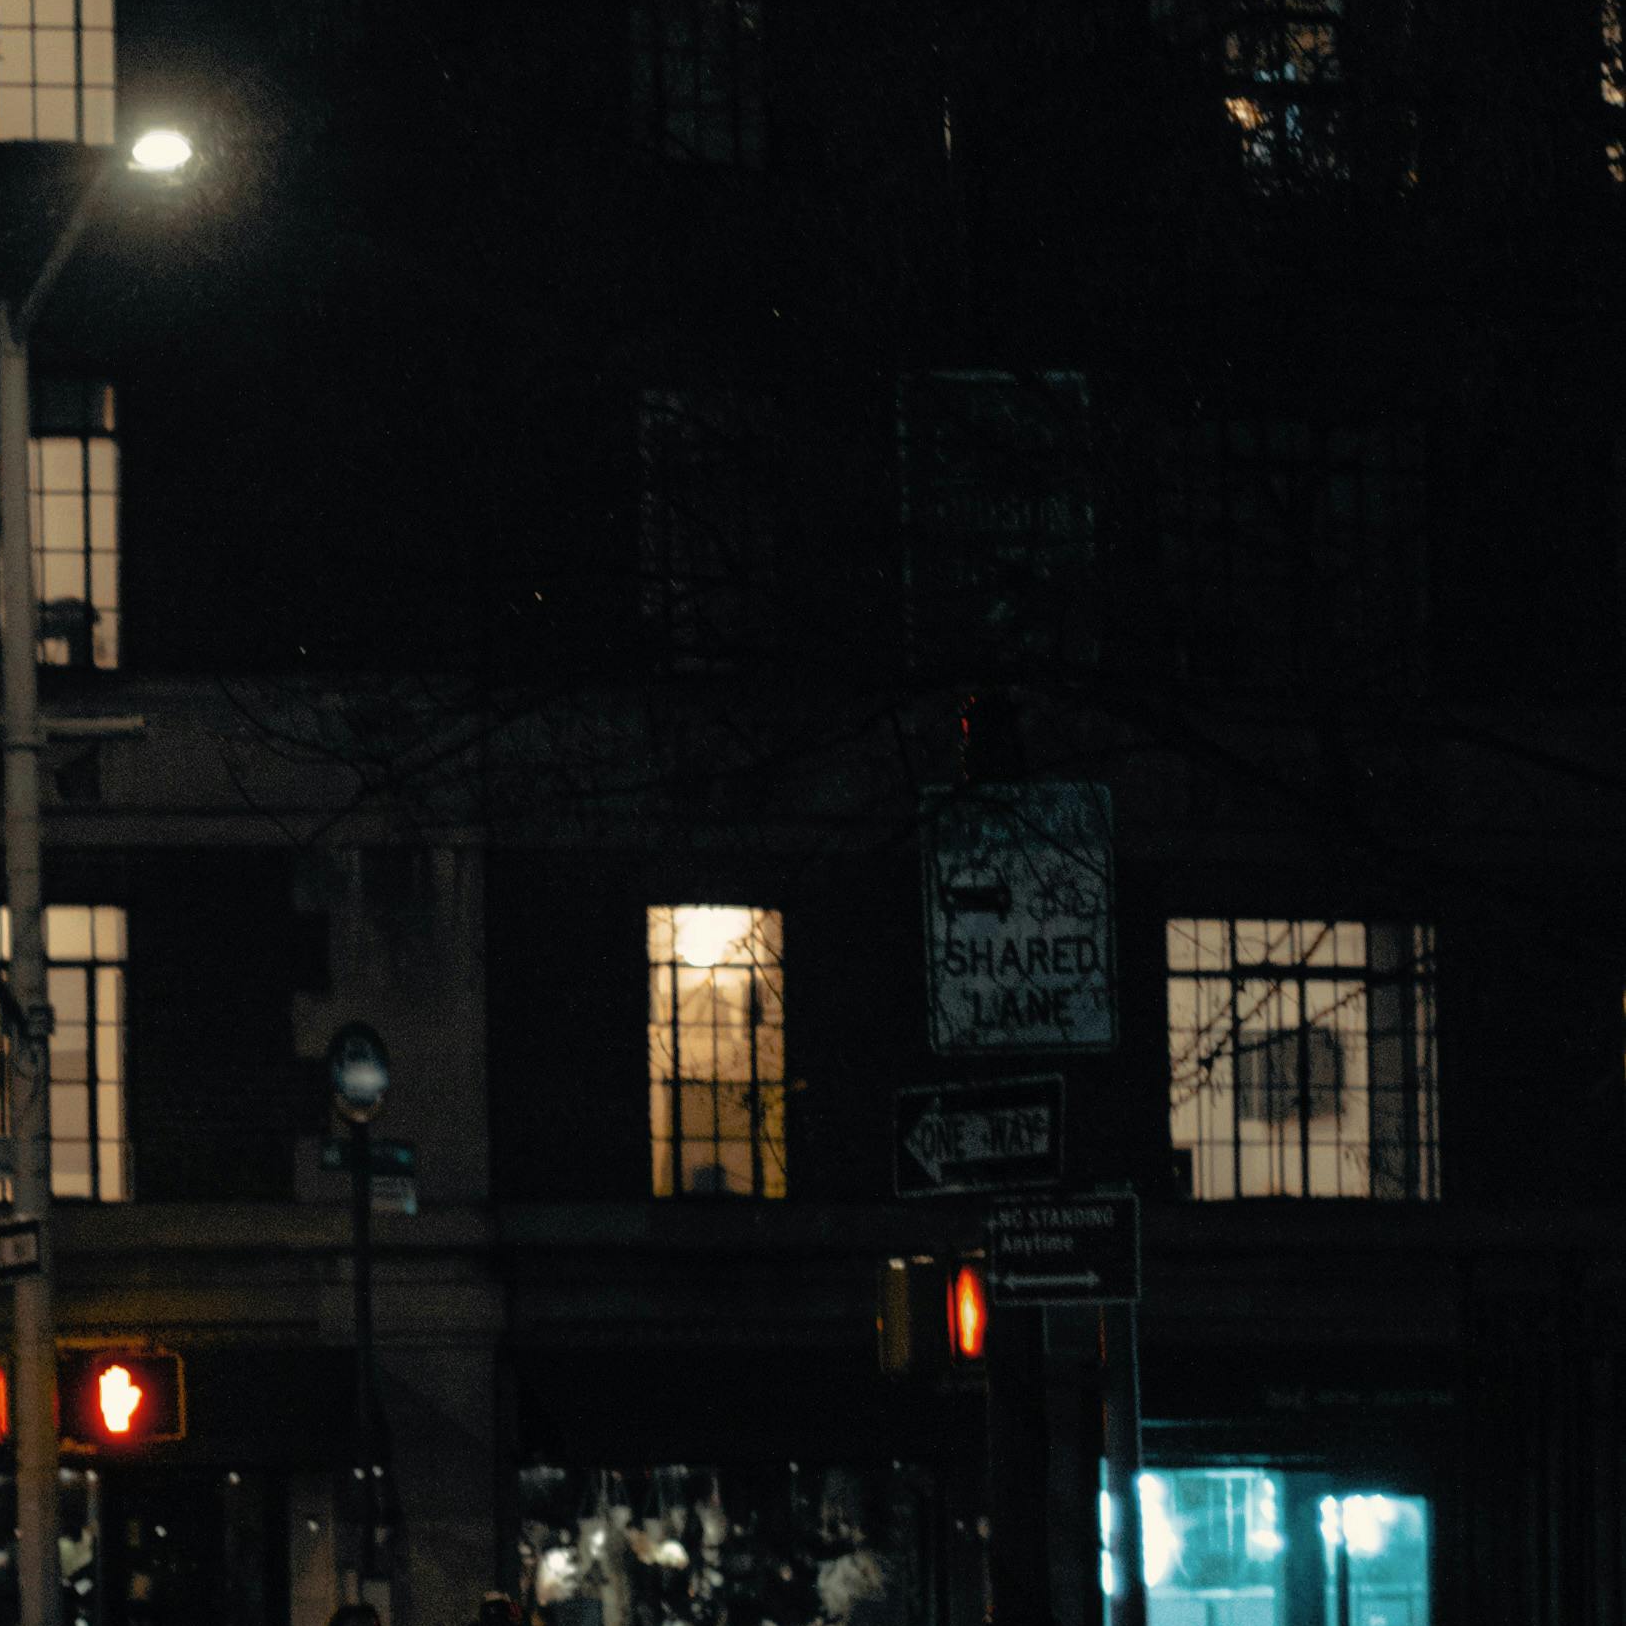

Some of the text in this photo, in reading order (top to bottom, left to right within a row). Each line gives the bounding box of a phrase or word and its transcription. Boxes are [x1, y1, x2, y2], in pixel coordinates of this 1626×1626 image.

[945, 936, 1100, 976] SHARED
[971, 987, 1076, 1028] LANE
[916, 1116, 964, 1159] ONE
[1029, 1206, 1115, 1228] STANDING
